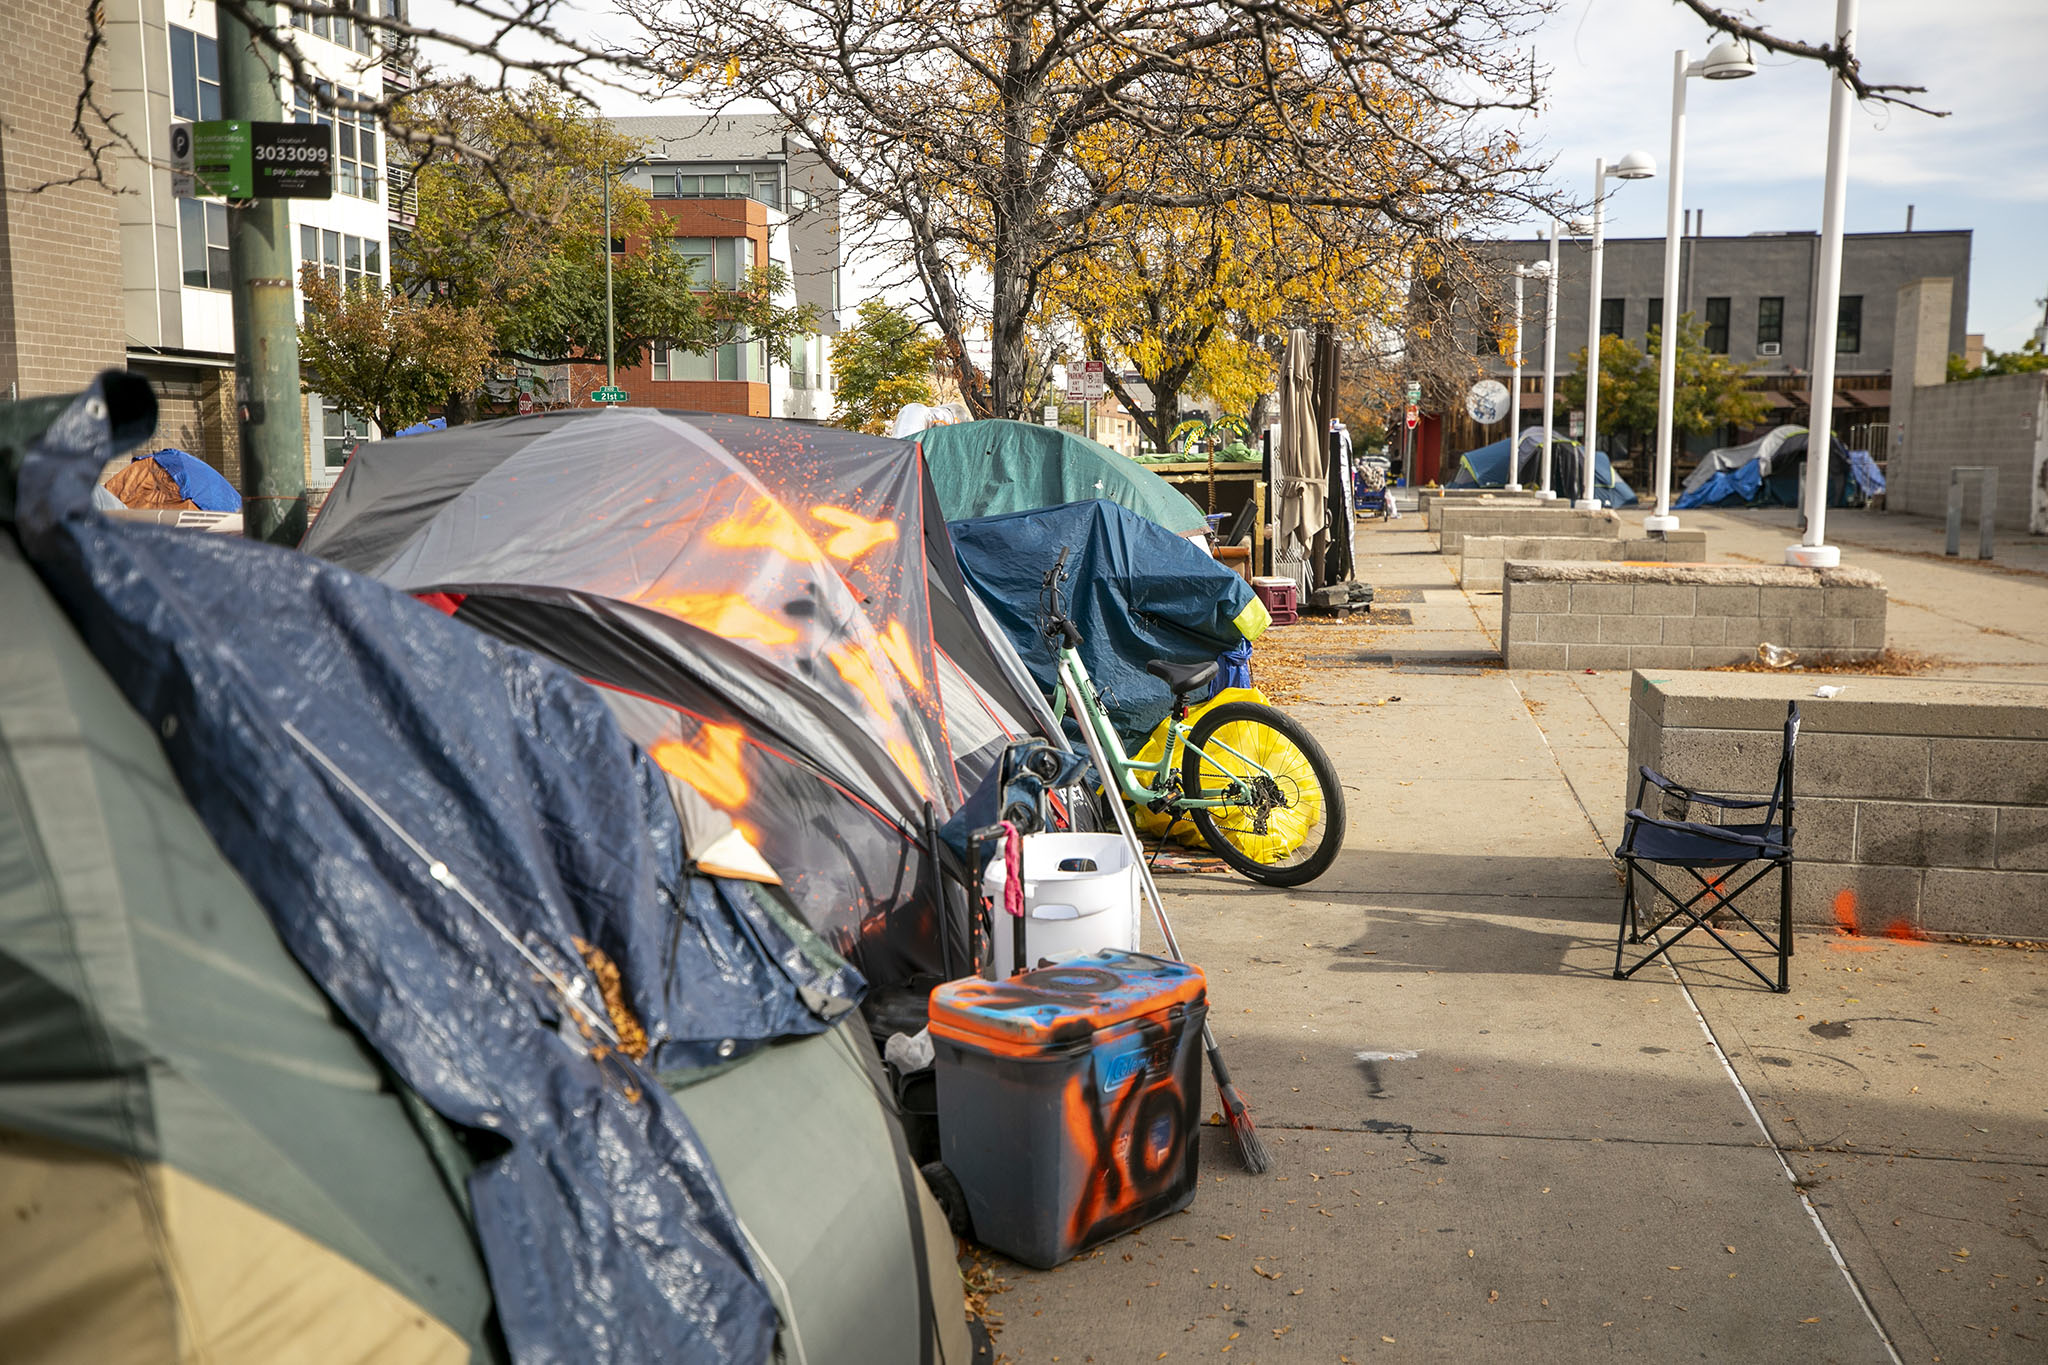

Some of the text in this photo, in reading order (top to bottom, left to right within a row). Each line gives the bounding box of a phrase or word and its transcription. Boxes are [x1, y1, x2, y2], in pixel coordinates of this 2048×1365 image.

[255, 145, 328, 162] 3033099
[272, 167, 320, 177] paybyphone
[601, 392, 617, 401] 21st
[520, 400, 533, 411] STOP
